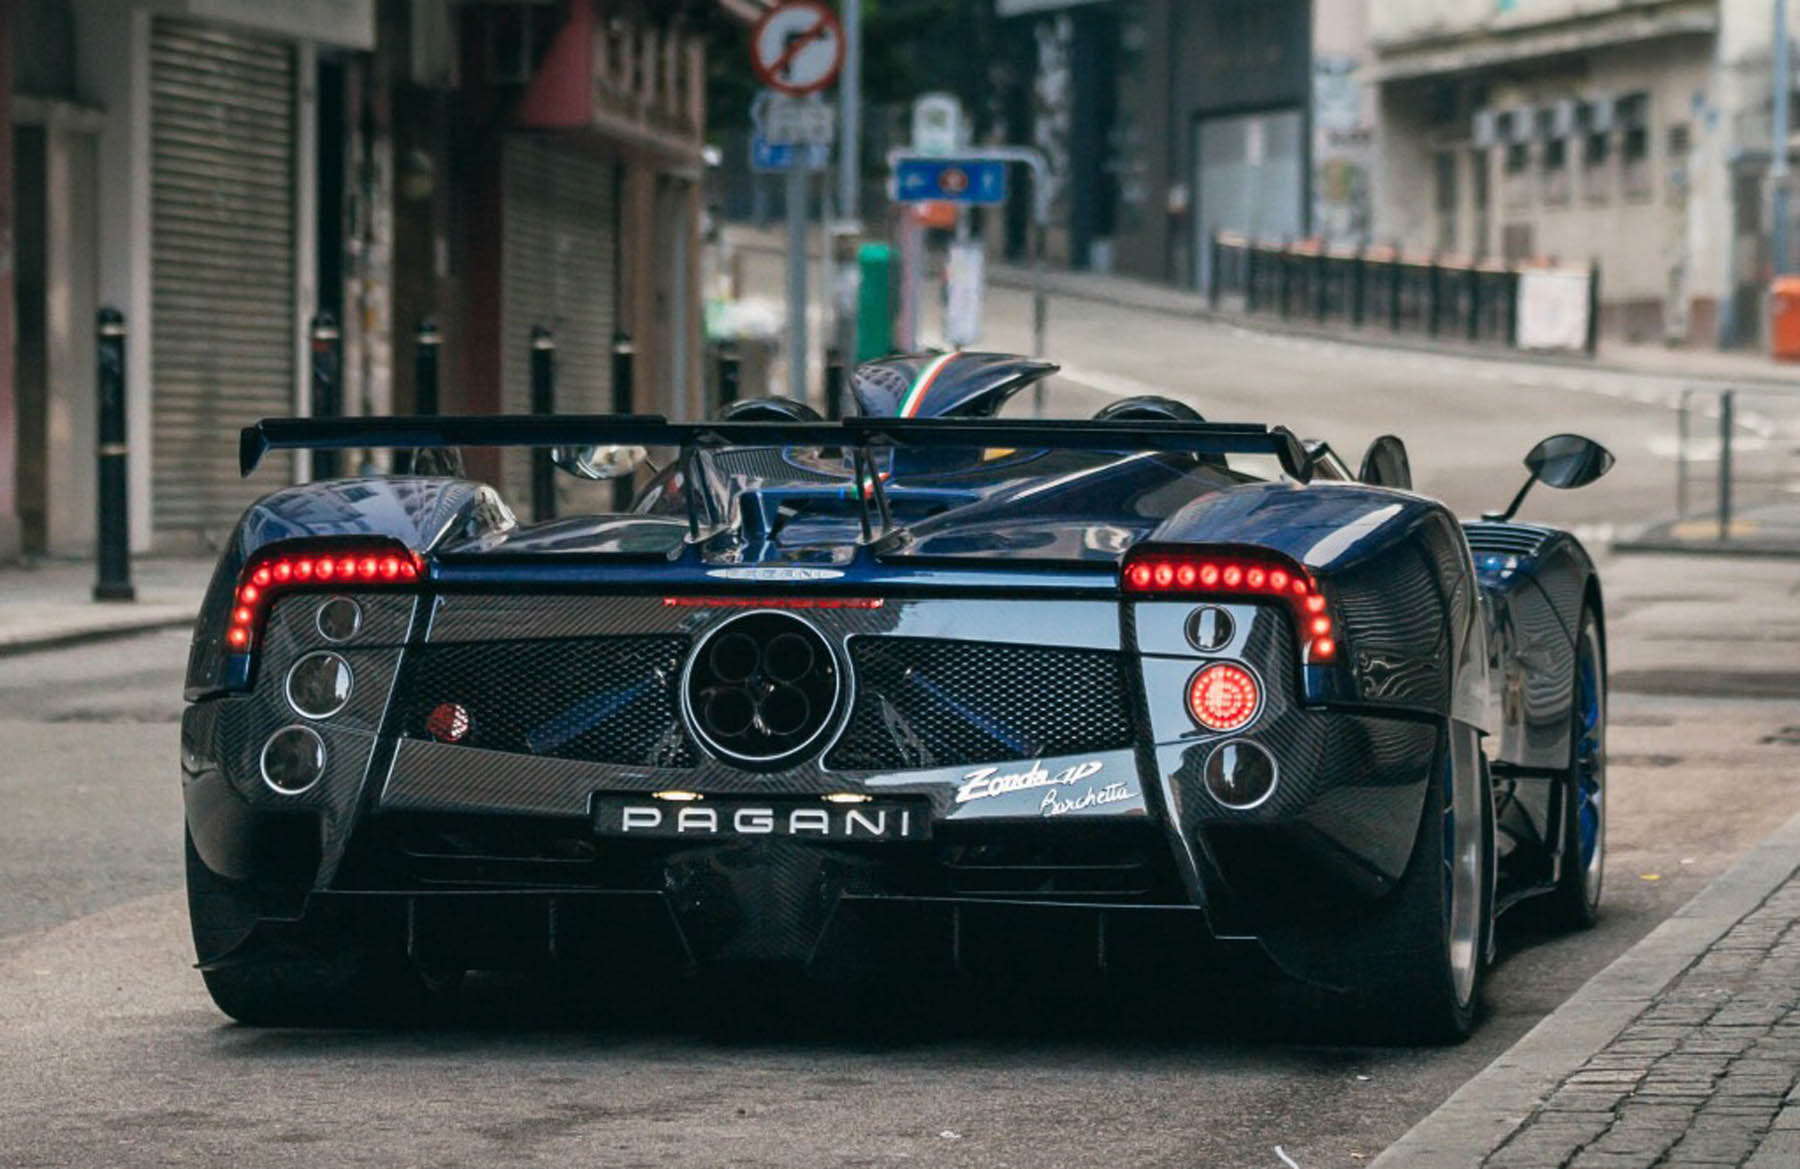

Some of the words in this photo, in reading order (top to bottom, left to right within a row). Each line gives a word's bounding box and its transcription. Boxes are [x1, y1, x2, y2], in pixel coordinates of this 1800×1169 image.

[955, 760, 1050, 803] Zonda
[1039, 781, 1139, 816] Barchetta
[622, 807, 909, 836] PAGANI
